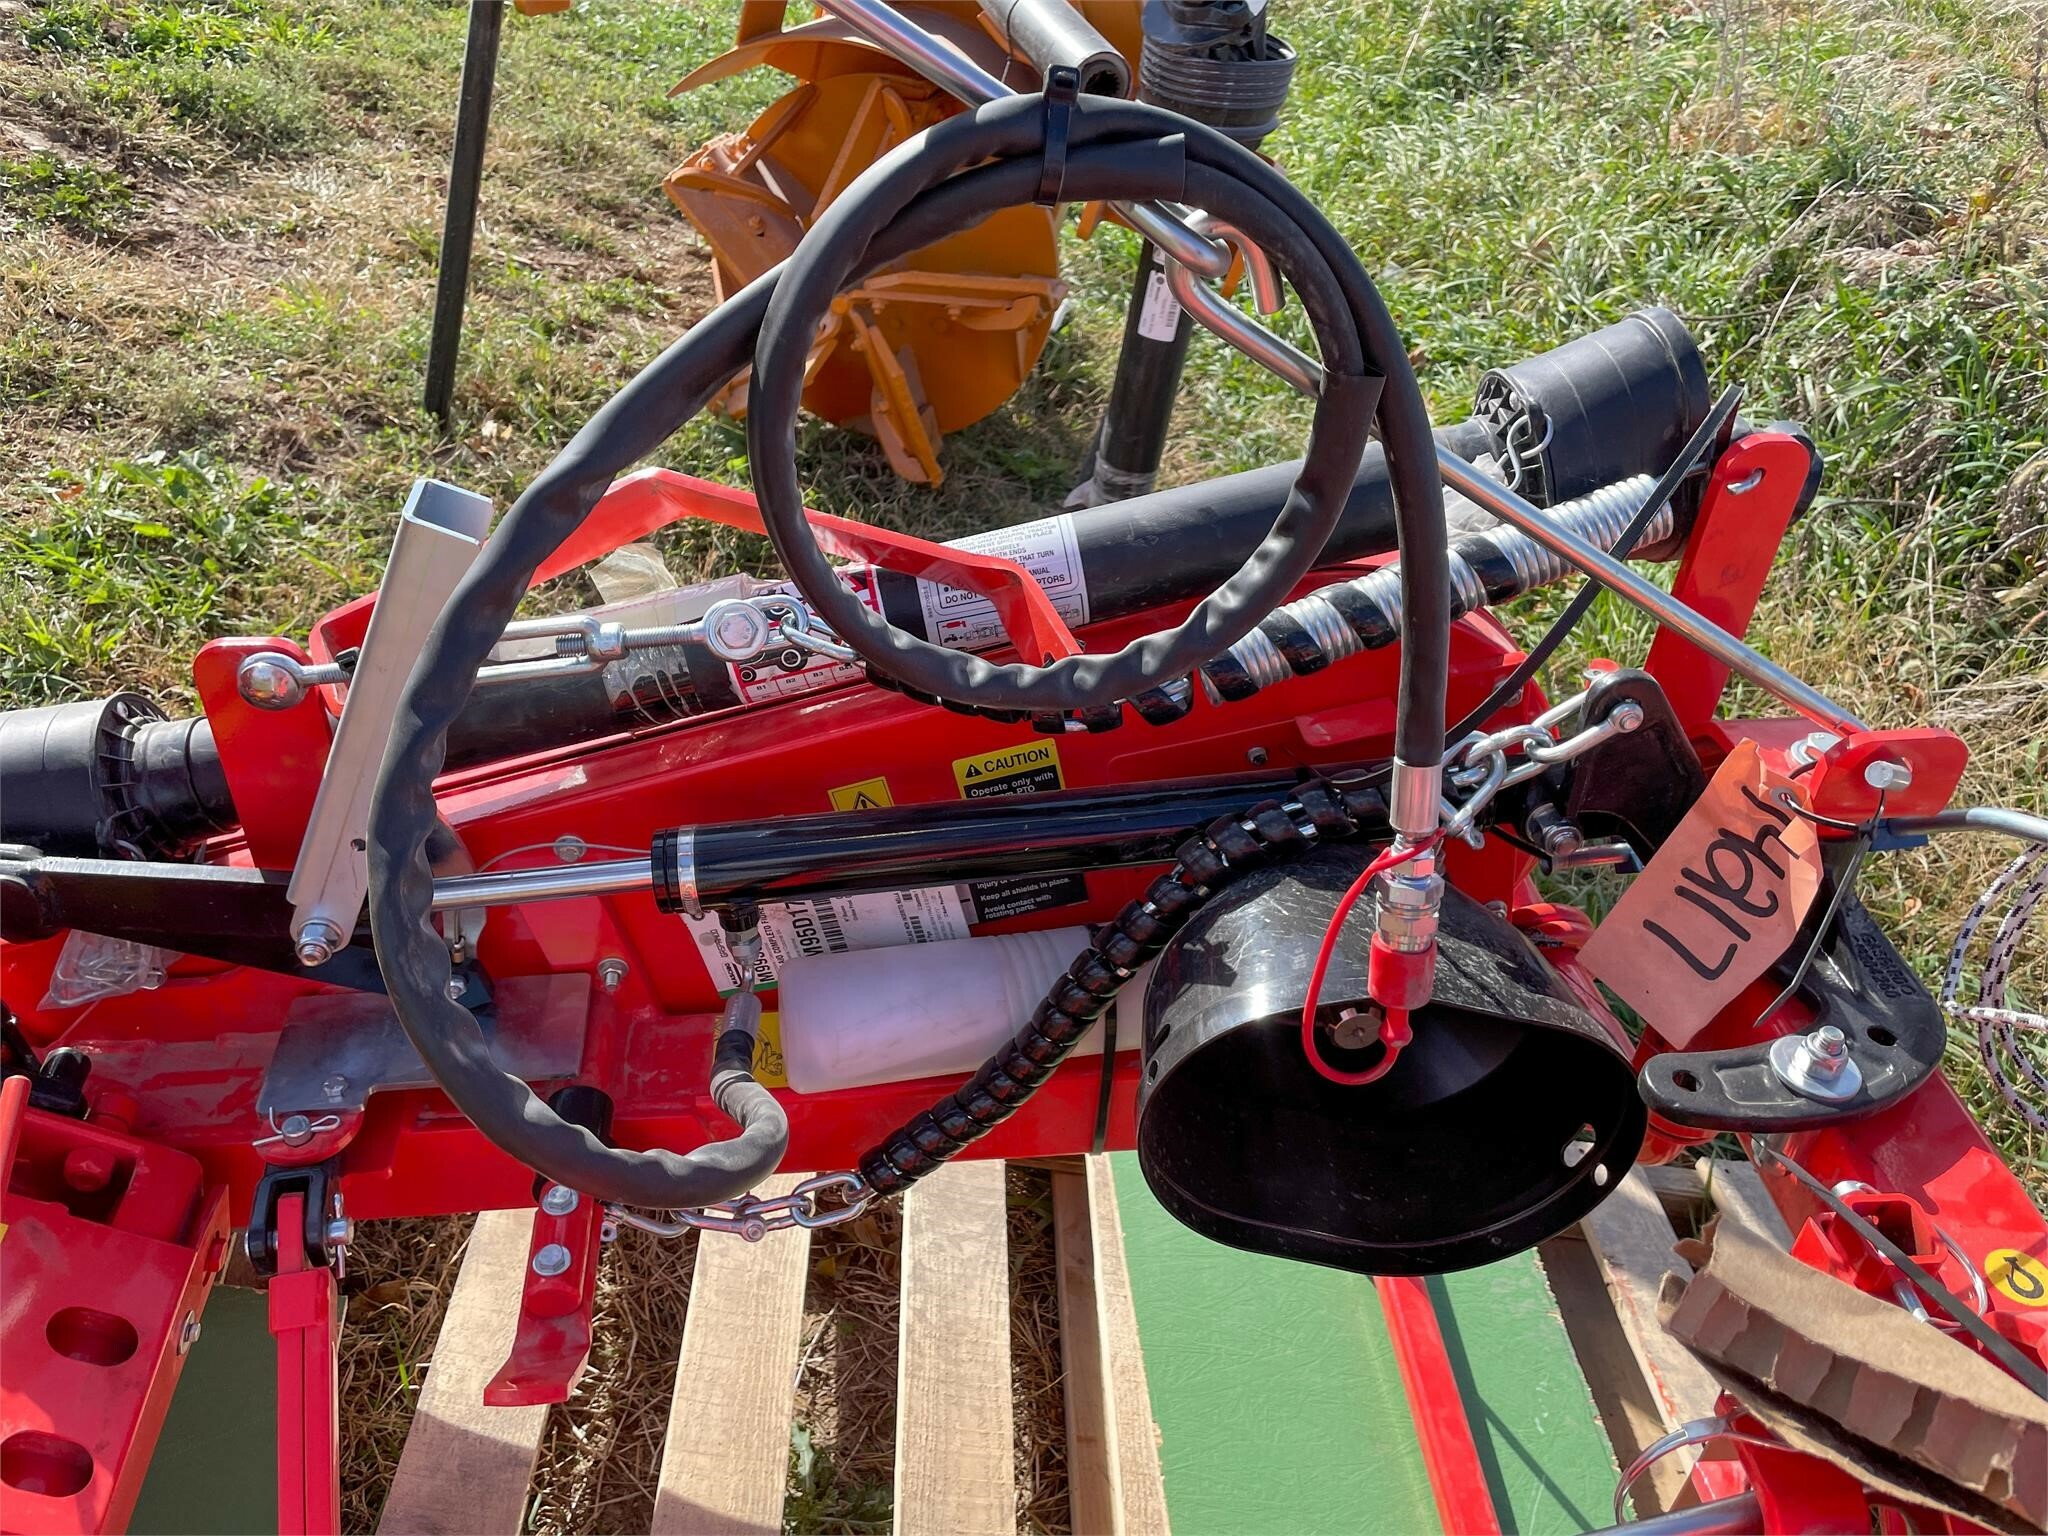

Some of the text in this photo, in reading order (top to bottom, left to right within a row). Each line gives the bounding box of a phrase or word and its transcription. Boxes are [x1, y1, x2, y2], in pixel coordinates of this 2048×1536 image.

[1008, 546, 1027, 556] ENDS
[1018, 553, 1036, 563] THAT
[1036, 549, 1055, 559] TURN
[1029, 566, 1051, 577] ANUAL
[944, 595, 959, 605] DO
[983, 747, 1051, 773] CAUTION
[970, 781, 1009, 798] Operate
[1011, 776, 1032, 789] only
[1034, 770, 1054, 782] with
[1016, 784, 1036, 795] PTO
[980, 876, 1072, 902] Keep all shields in place.
[983, 893, 1052, 914] Avoid contact with
[985, 902, 1038, 920] rotating parts.
[763, 924, 782, 954] COMPLETO
